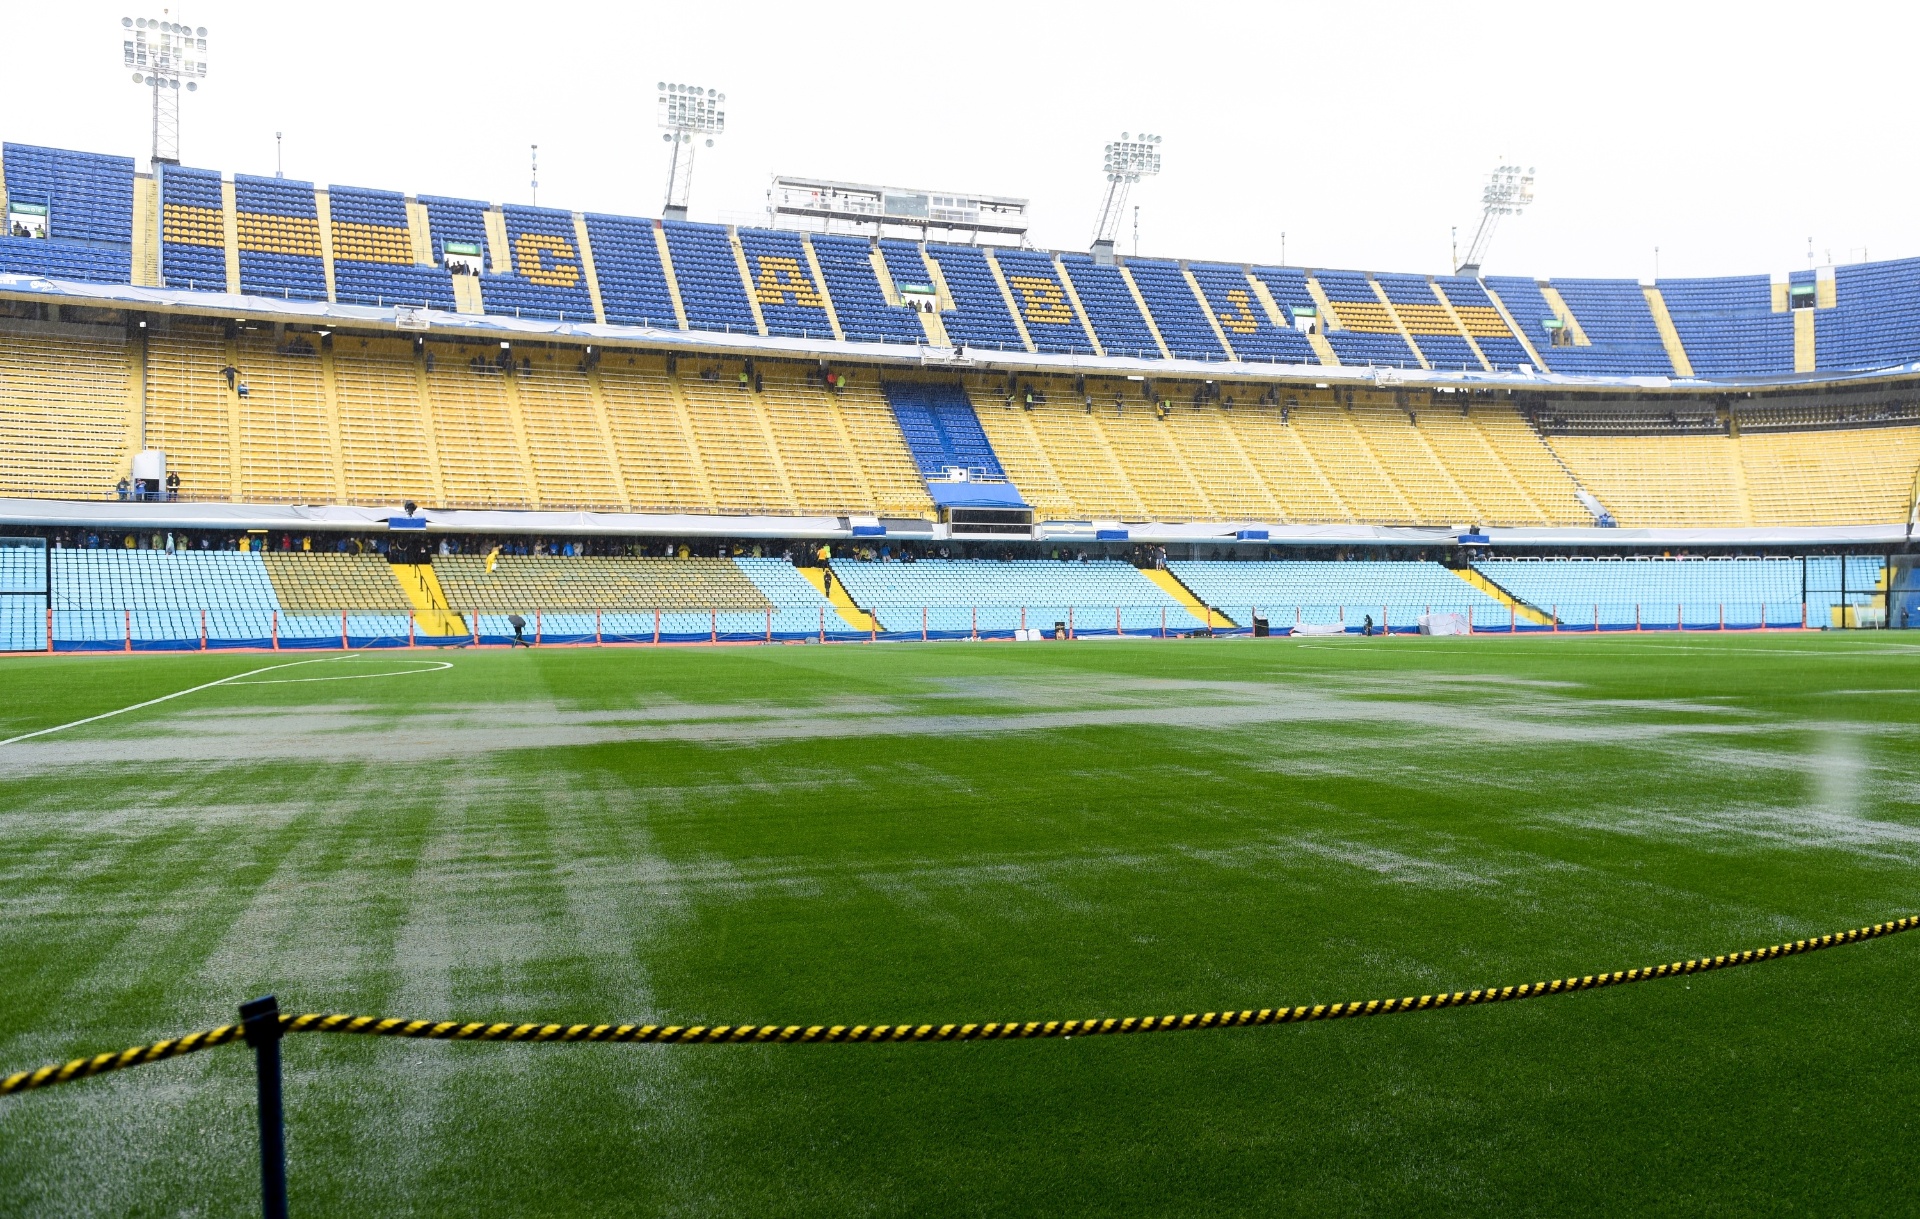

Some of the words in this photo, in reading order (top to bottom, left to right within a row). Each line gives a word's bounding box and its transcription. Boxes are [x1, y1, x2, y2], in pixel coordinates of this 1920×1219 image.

[515, 233, 579, 287] C
[755, 256, 824, 307] A
[1010, 276, 1073, 324] B
[1220, 290, 1258, 333] J
